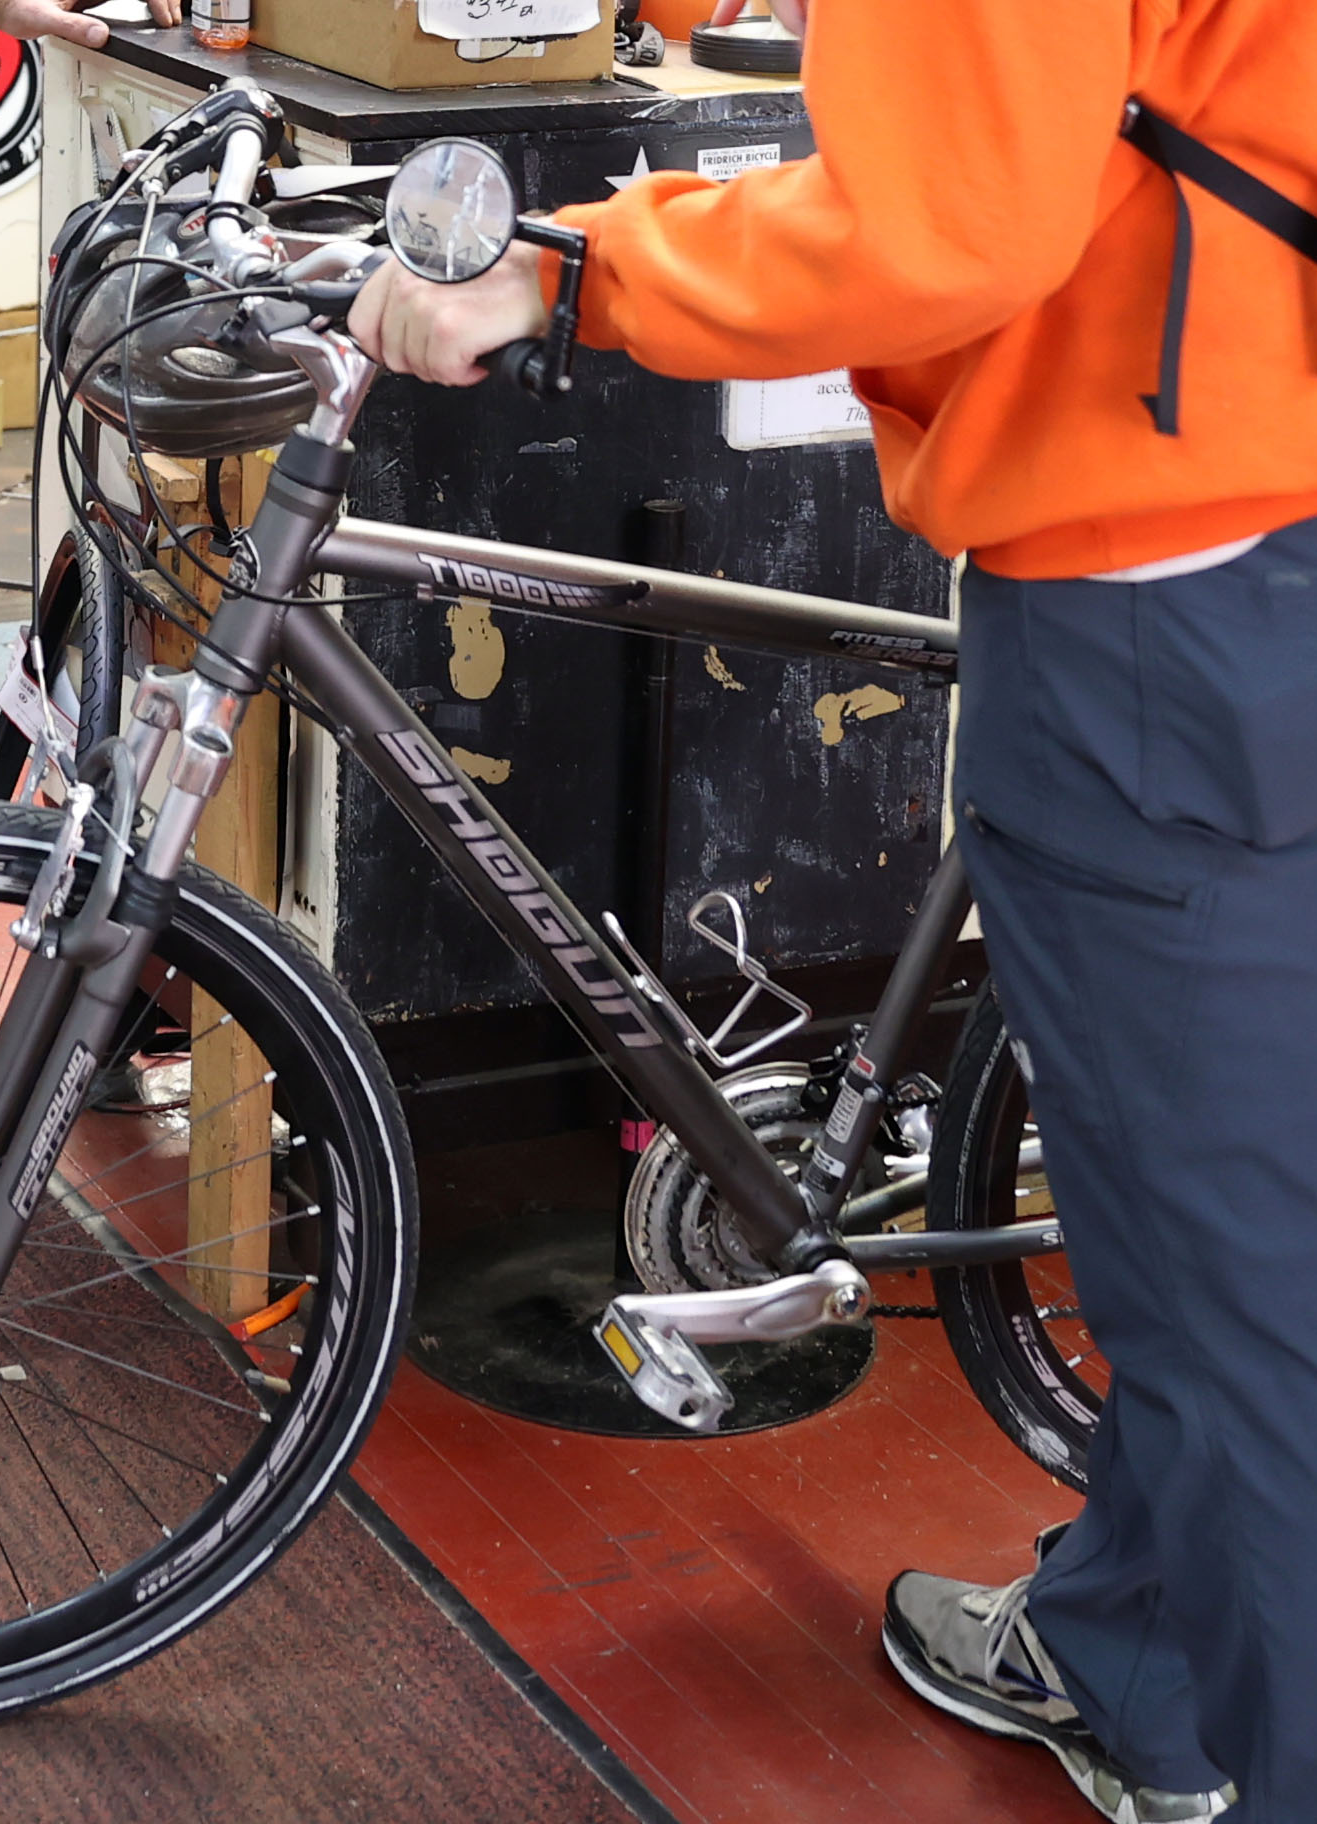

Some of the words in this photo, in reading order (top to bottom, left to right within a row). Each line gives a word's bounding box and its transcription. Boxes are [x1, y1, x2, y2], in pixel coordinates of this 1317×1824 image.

[702, 154, 743, 166] FRIDRICH
[745, 151, 778, 162] BICYCLE
[416, 551, 549, 607] T1000
[828, 629, 927, 650] FITNESS
[375, 728, 665, 1048] SHOGUN
[30, 1044, 85, 1161] GROUND
